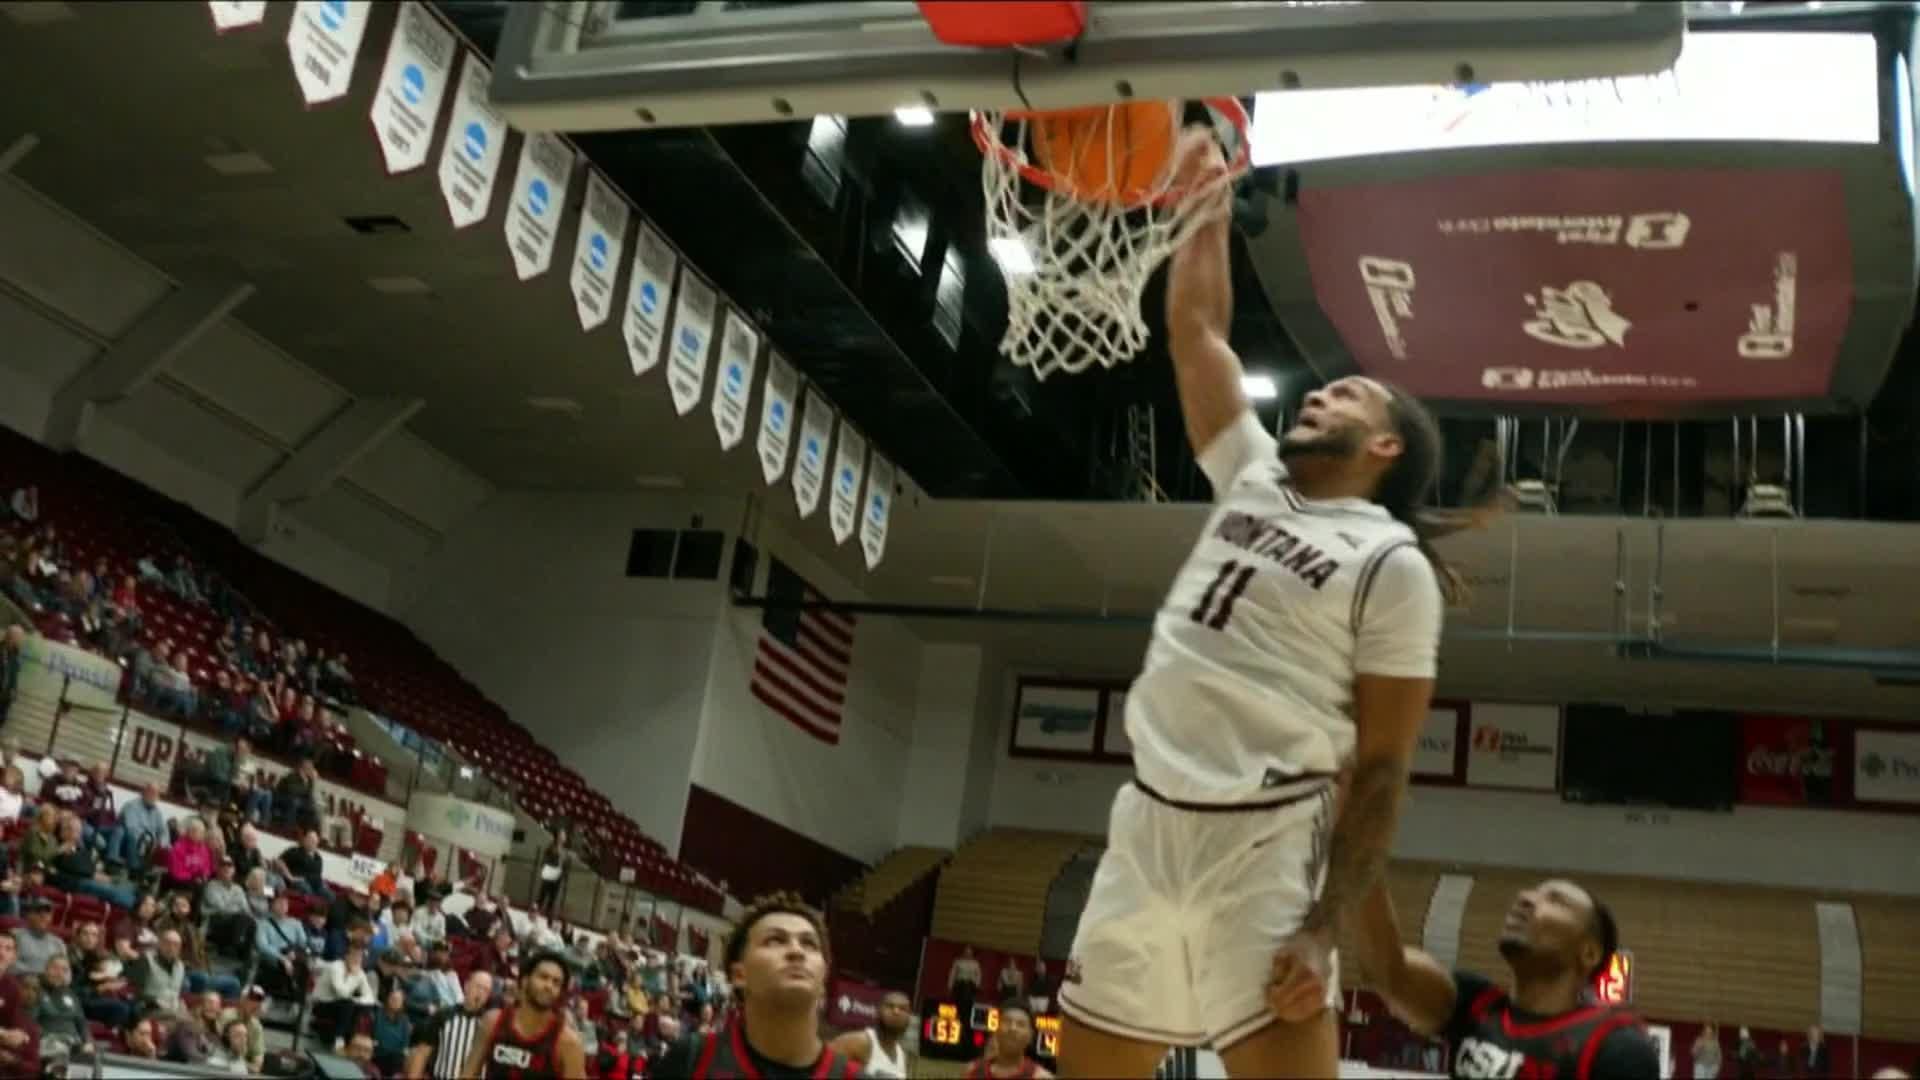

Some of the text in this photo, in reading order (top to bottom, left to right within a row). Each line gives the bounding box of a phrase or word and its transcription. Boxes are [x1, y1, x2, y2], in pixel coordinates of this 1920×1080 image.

[1190, 559, 1257, 631] 11
[132, 726, 173, 769] UP
[936, 1018, 962, 1045] 53
[987, 1007, 1000, 1033] 6
